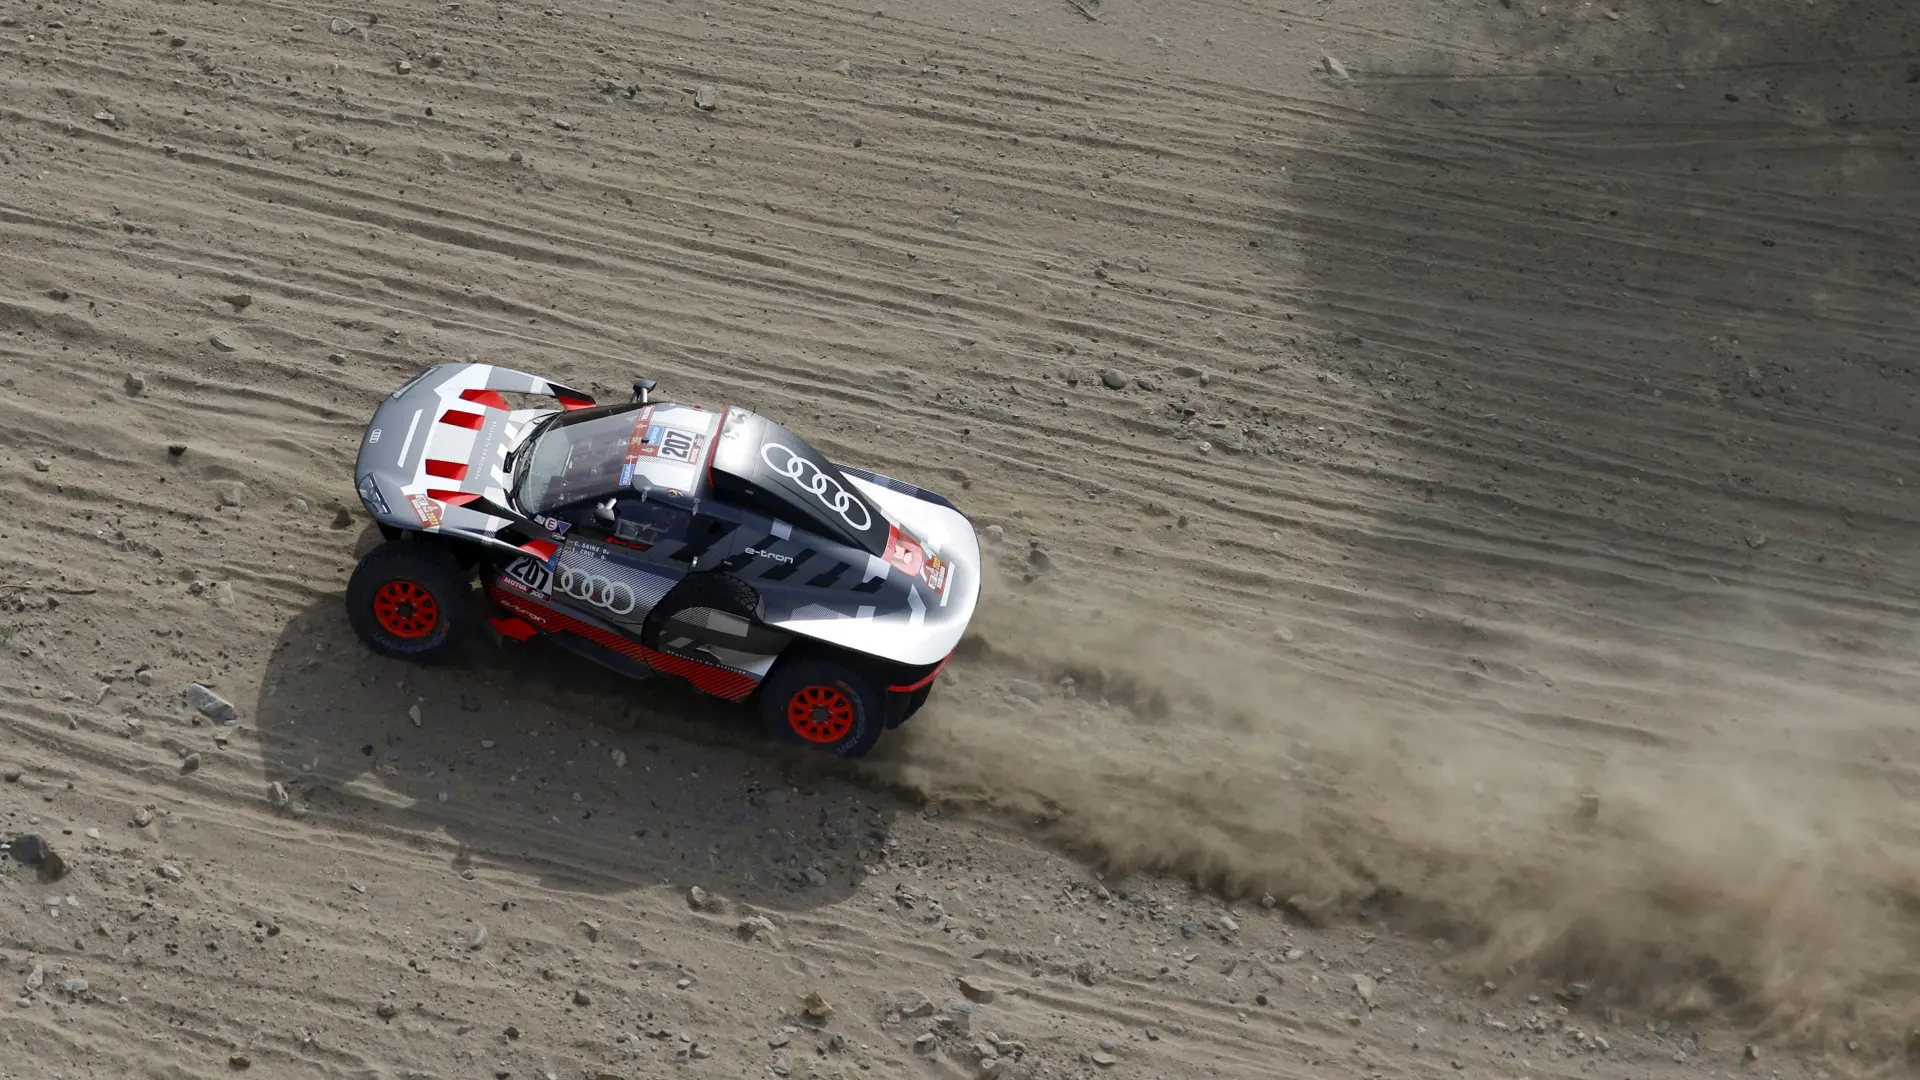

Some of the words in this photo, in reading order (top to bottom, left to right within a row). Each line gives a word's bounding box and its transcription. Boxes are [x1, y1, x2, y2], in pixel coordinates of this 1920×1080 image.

[662, 431, 692, 458] 207
[547, 519, 556, 529] E
[581, 542, 600, 552] SAINZ
[744, 547, 794, 564] e-tron
[511, 558, 550, 590] 207
[503, 577, 528, 591] MOTUL
[500, 599, 547, 624] e-tron
